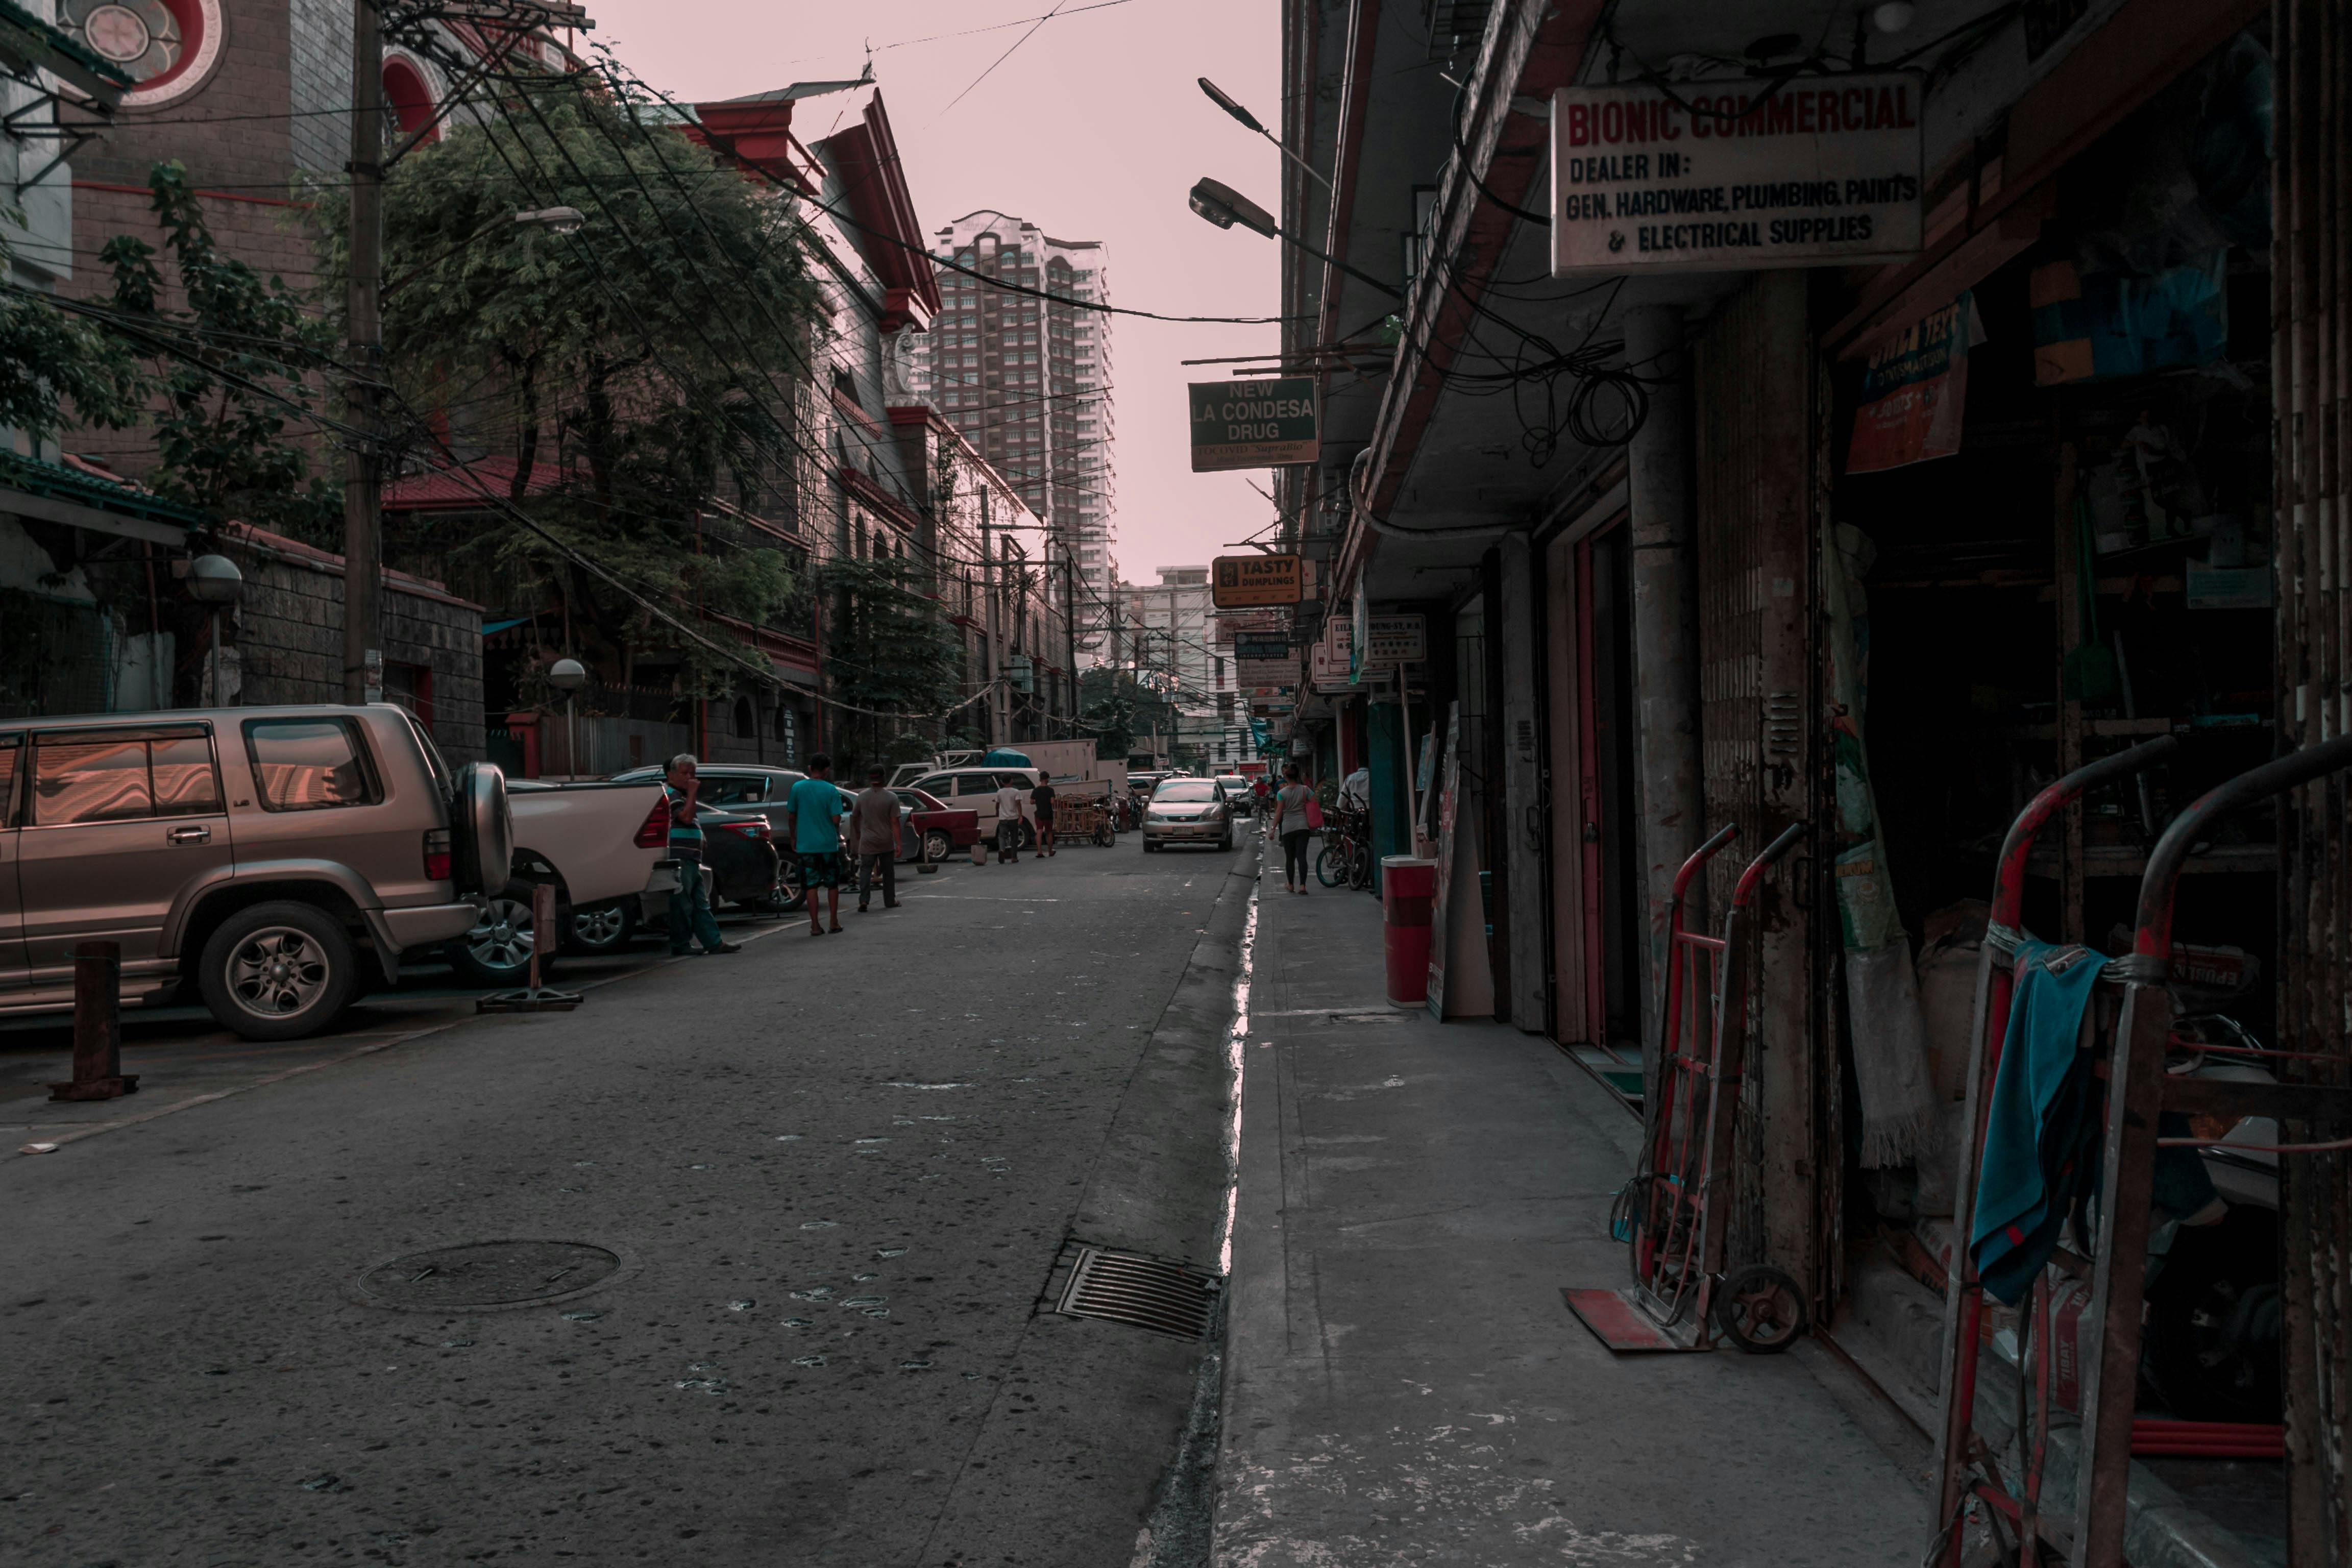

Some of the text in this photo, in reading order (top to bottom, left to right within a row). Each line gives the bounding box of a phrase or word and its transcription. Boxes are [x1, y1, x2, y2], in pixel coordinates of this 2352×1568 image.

[1569, 86, 1915, 146] BIONIC COMMERCIAL
[1571, 153, 1691, 183] DEALER IN:
[1566, 193, 1612, 220] GEN.
[1616, 186, 1729, 217] HARDWARE,
[1846, 177, 1917, 204] PAINTS
[1608, 215, 1872, 252] & ELECTRICAL SUPPLIES
[1229, 381, 1275, 398] NEW
[1192, 399, 1314, 423] LA CONDESA
[1228, 422, 1280, 440] DRUG
[1242, 559, 1294, 575] TASTY
[1242, 576, 1294, 586] DUMPLINGS
